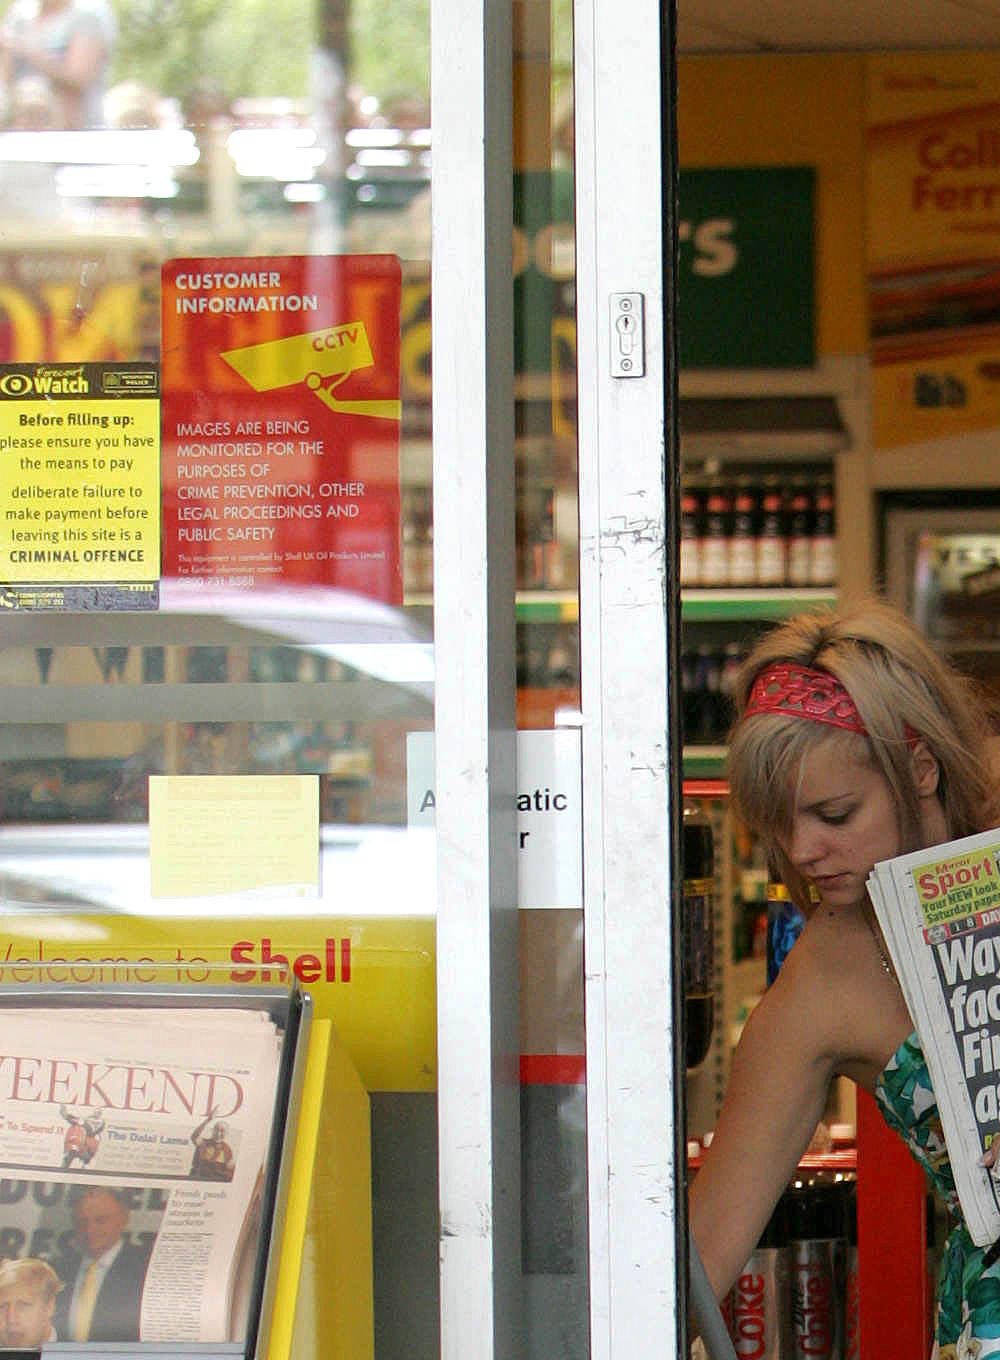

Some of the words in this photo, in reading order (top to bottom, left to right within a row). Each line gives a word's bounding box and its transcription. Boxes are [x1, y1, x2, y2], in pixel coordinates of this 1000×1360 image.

[175, 272, 281, 289] CUSTOMER
[175, 295, 318, 314] INFORMATION
[311, 328, 359, 352] CCTV
[34, 377, 89, 394] Watch
[19, 414, 63, 426] Before
[67, 413, 106, 428] filling
[113, 416, 134, 428] up:
[176, 422, 231, 436] IMAGES
[235, 422, 262, 436] ARE
[267, 421, 310, 435] BEING
[0, 436, 42, 449] please
[46, 437, 91, 448] ensure
[95, 438, 119, 450] you
[122, 435, 154, 447] have
[177, 443, 263, 457] MONITORED
[267, 443, 295, 456] FOR
[299, 442, 324, 455] THE
[20, 458, 42, 470] the
[45, 459, 89, 470] means
[92, 458, 107, 470] to
[110, 459, 133, 472] pay
[177, 465, 246, 479] PURPOSES
[251, 464, 270, 477] OF
[12, 486, 79, 499] deliberate
[82, 485, 124, 498] failure
[128, 487, 142, 498] to
[178, 485, 219, 499] CRIME
[224, 484, 315, 501] PREVENTION,
[319, 483, 364, 497] OTHER
[6, 507, 41, 520] make
[44, 508, 101, 523] payment
[105, 507, 148, 519] before
[178, 506, 219, 520] LEGAL
[223, 505, 322, 520] PROCEEDINGS
[326, 504, 359, 518] AND
[12, 529, 59, 543] leaving
[63, 528, 88, 541] this
[92, 528, 118, 541] site
[121, 529, 131, 541] is
[134, 530, 142, 541] a
[178, 528, 222, 542] PUBLIC
[227, 527, 276, 541] SAFETY
[9, 550, 80, 563] CRIMINAL
[83, 550, 144, 562] OFFENCE
[285, 552, 301, 560] Shell
[919, 857, 993, 900] Sport
[922, 896, 948, 912] Your
[947, 890, 974, 906] NEW
[975, 882, 997, 898] look
[926, 903, 973, 924] Saturday
[174, 948, 210, 983] to
[229, 938, 352, 984] Shell
[107, 1131, 126, 1140] The
[130, 1133, 157, 1141] Dalai
[160, 1136, 189, 1145] Lama
